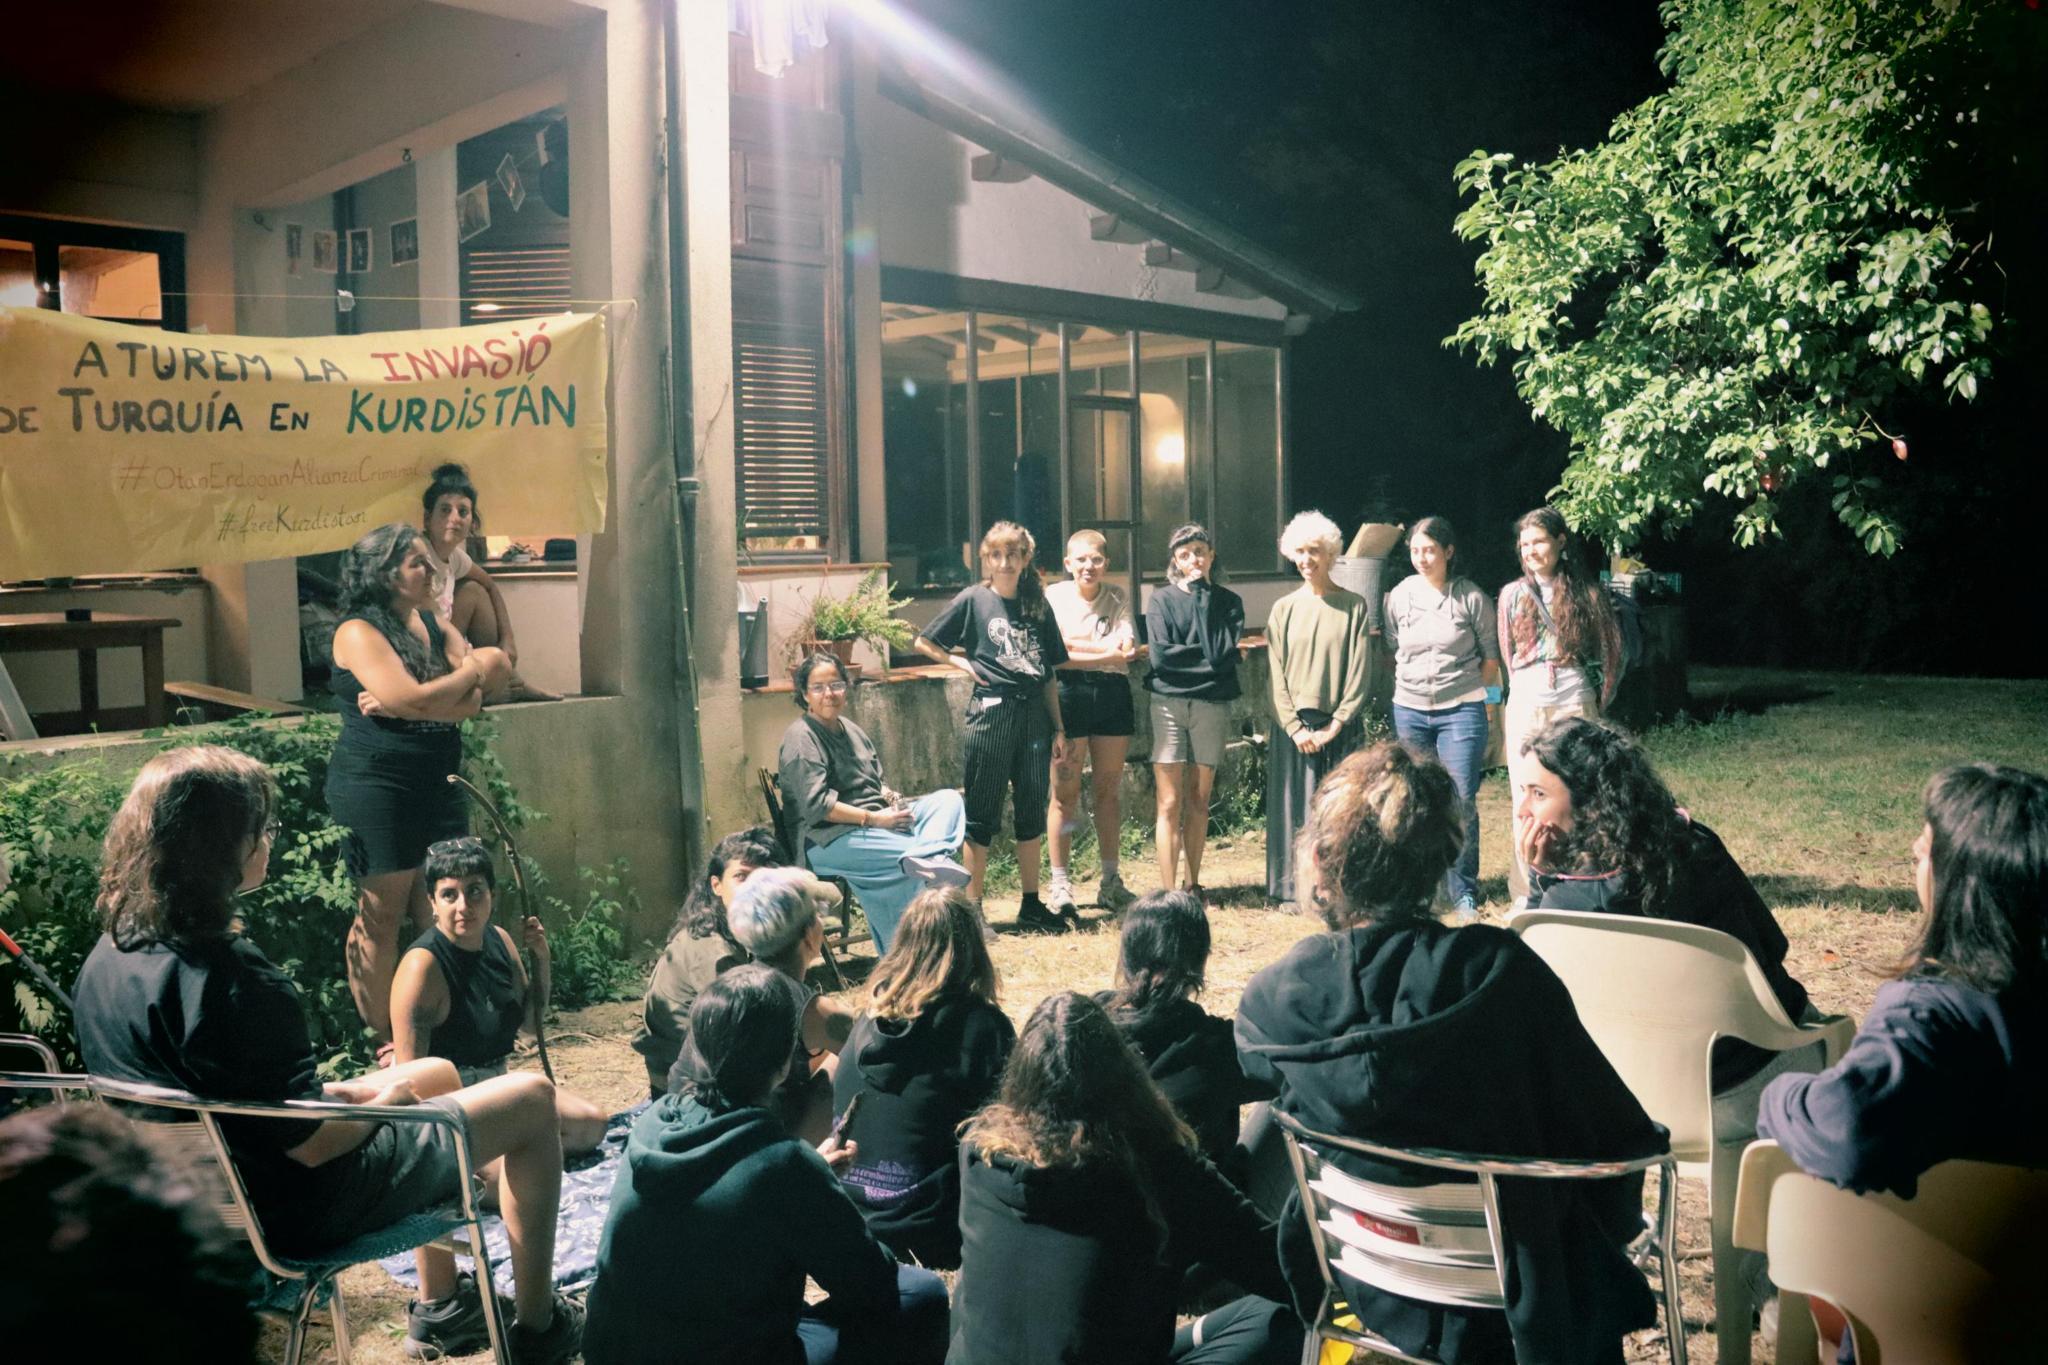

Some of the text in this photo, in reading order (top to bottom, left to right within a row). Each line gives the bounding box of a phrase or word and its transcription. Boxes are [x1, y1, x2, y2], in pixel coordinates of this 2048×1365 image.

[73, 340, 273, 381] ATUREM
[294, 356, 348, 382] LA
[0, 406, 39, 433] DE
[57, 386, 244, 433] TURQUÍA
